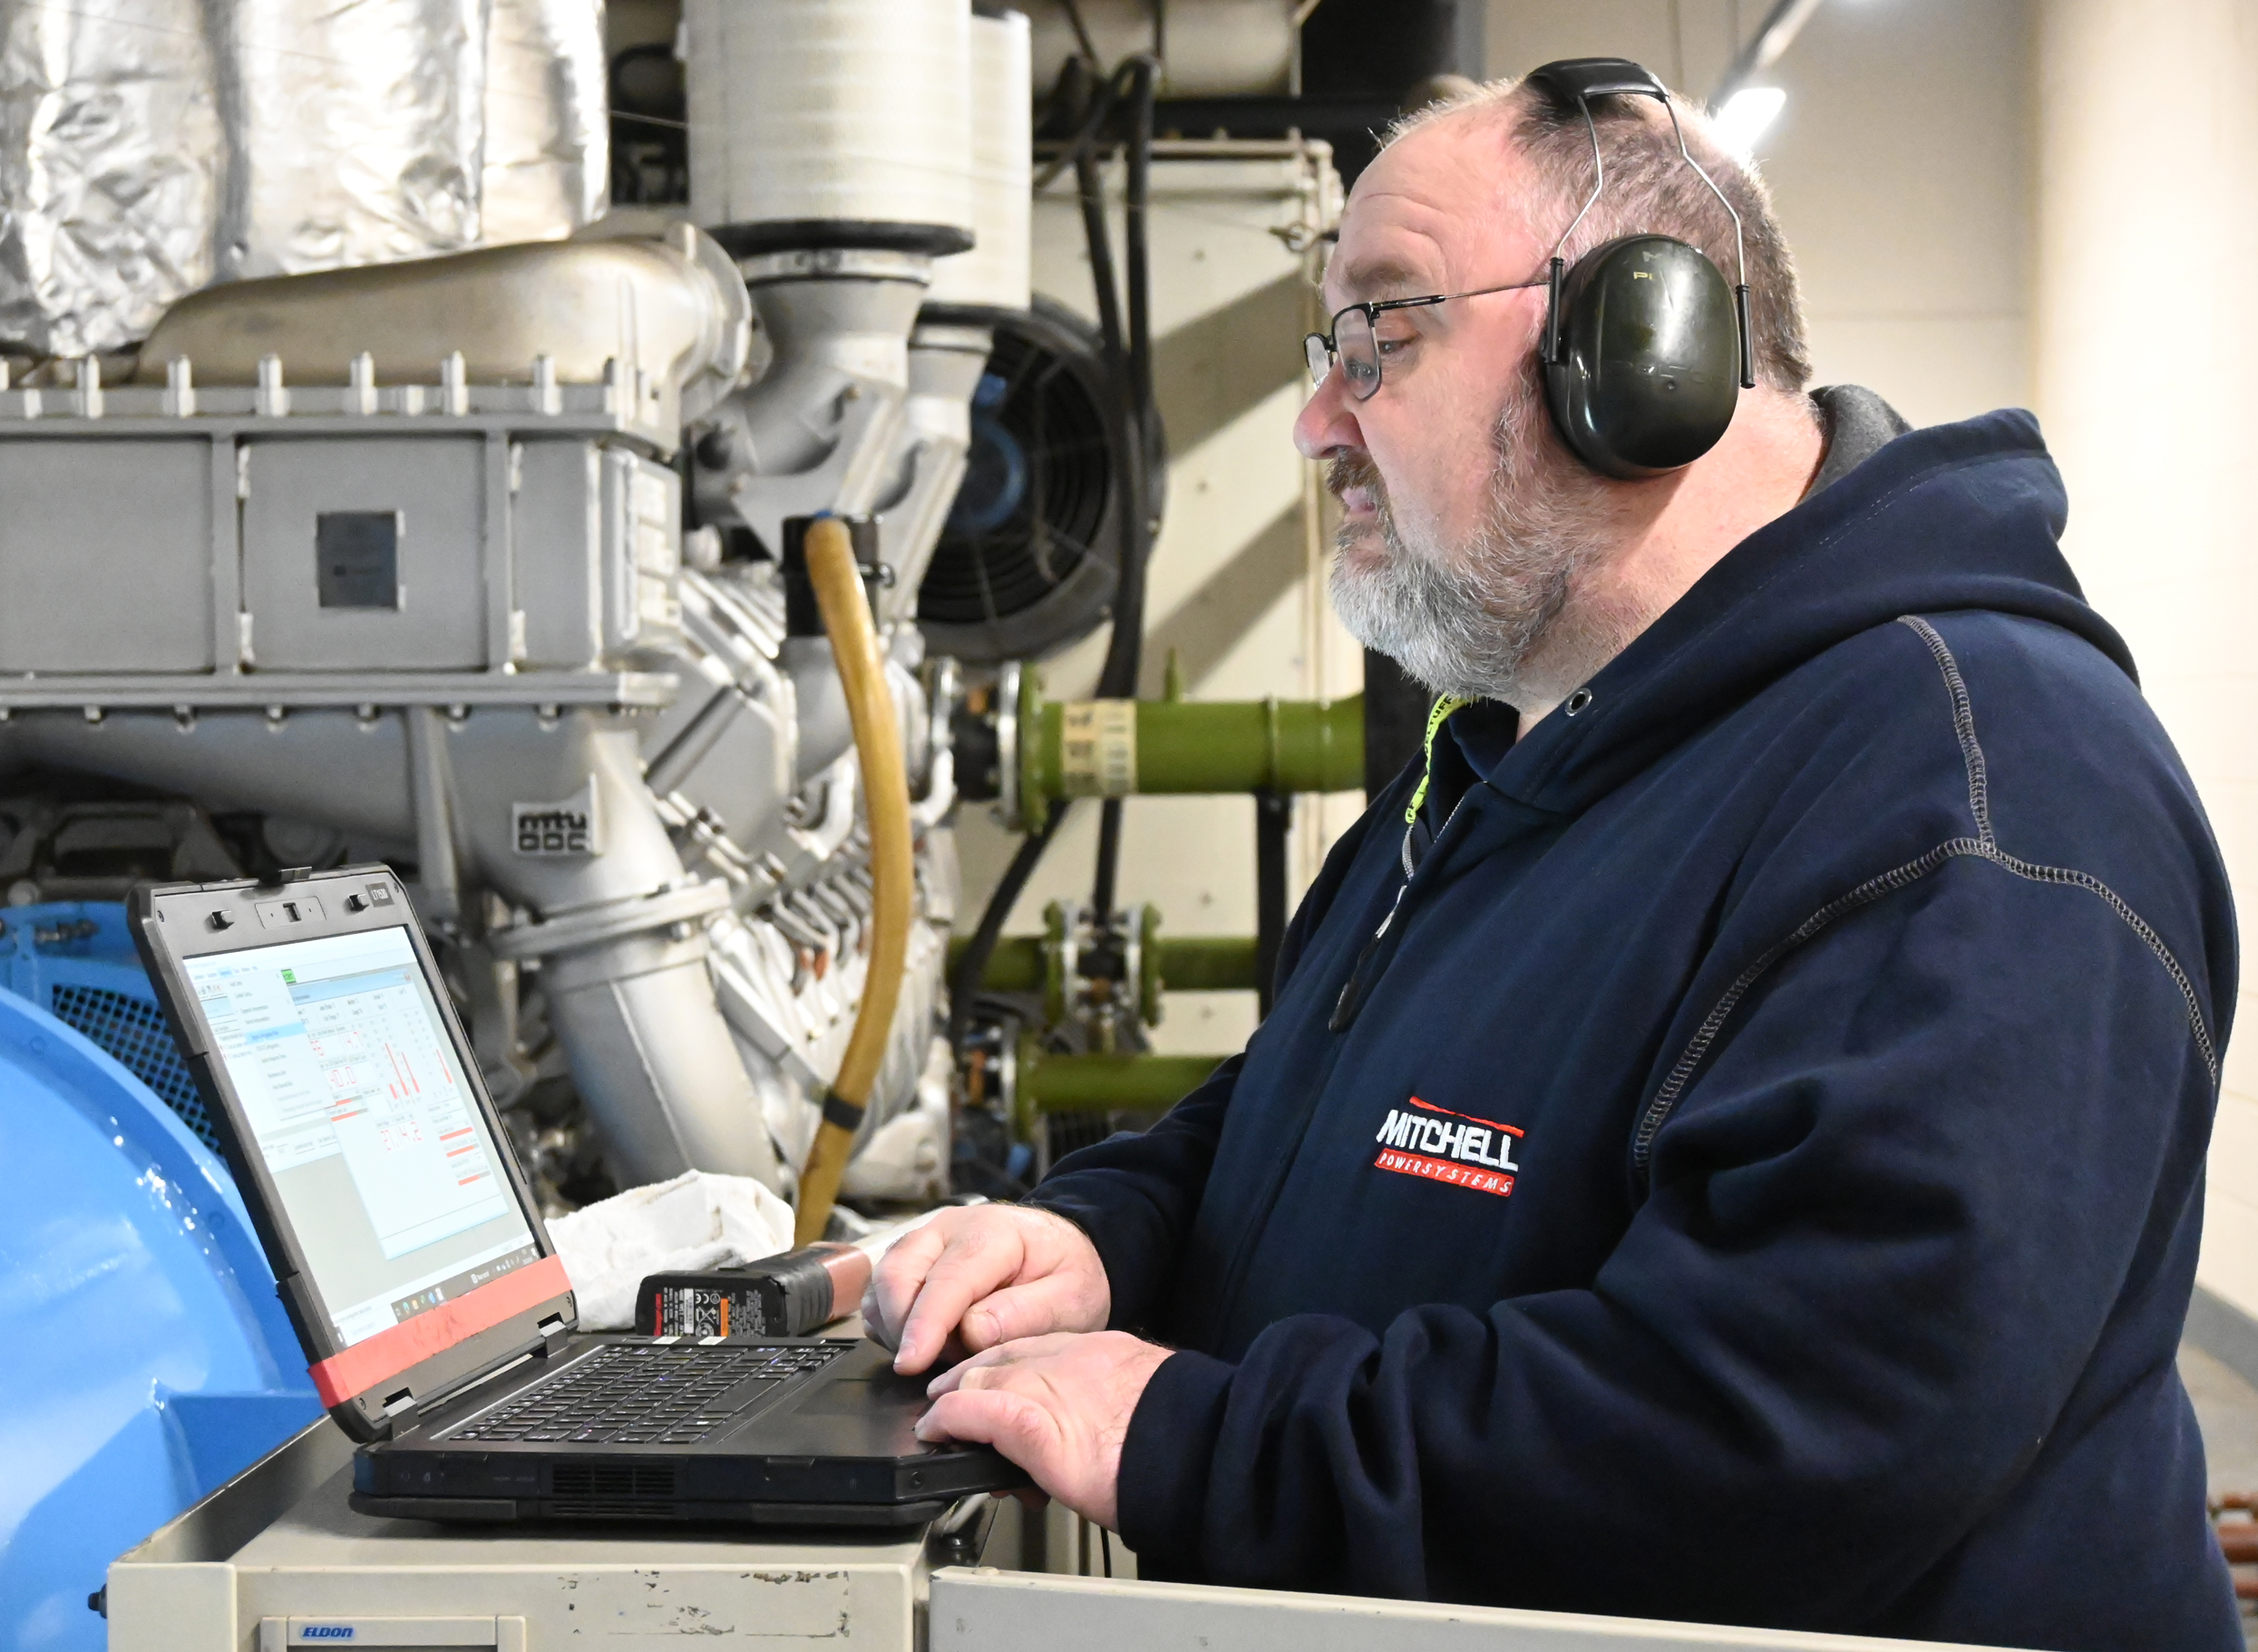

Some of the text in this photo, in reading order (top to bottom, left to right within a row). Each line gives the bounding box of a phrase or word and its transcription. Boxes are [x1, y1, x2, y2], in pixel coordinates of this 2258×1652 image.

[519, 811, 587, 829] mtu
[1376, 1109, 1519, 1172] MITCHELL
[302, 1627, 354, 1638] ELDON
